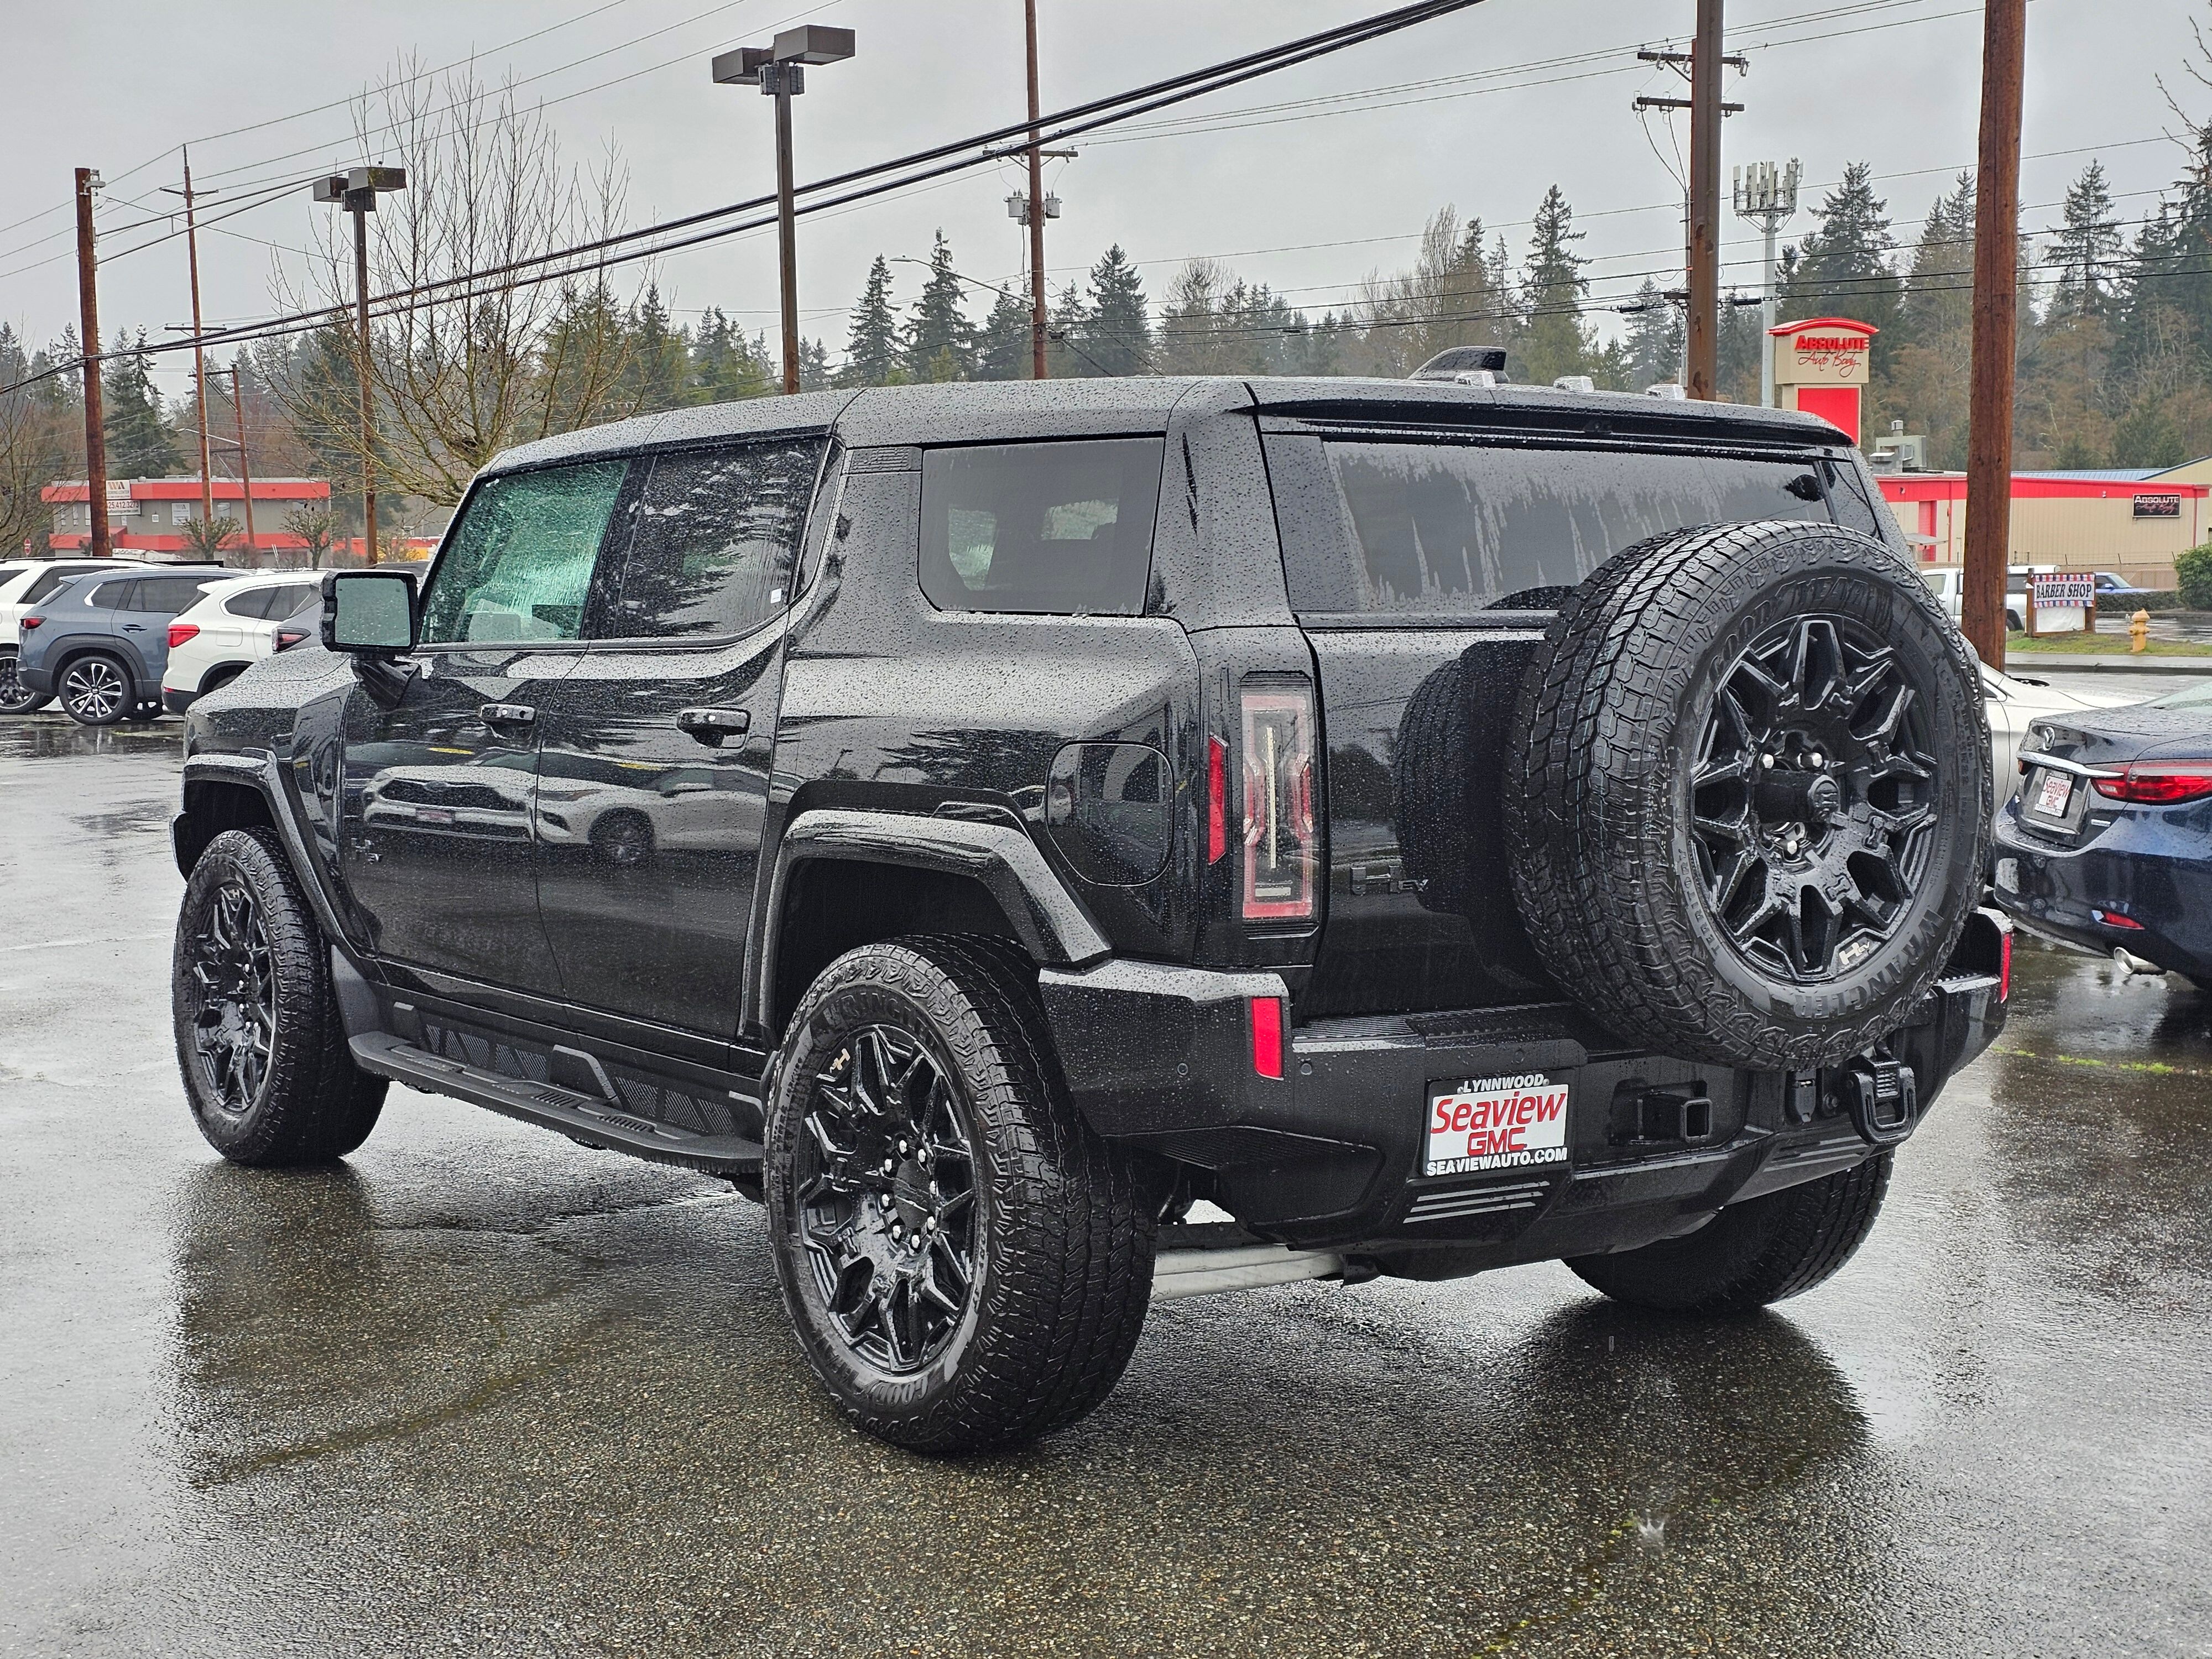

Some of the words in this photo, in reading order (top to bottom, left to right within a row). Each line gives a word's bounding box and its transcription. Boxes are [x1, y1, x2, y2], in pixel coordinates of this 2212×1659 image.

[1795, 335, 1869, 350] ABSOLUTE
[1798, 350, 1833, 372] Auto
[1832, 349, 1861, 378] Body
[2135, 495, 2179, 504] ABSOLUTE
[2036, 584, 2066, 598] BARBER
[2067, 583, 2092, 597] SHOP
[2042, 778, 2070, 799] Seaview
[1678, 848, 1720, 957] TERRITORY
[1794, 909, 1945, 1019] WRANGLER
[1463, 1074, 1545, 1093] LYNNWOOD
[1431, 1091, 1567, 1134] Seaview
[1467, 1126, 1526, 1156] GMC
[1427, 1147, 1568, 1176] SEAVIEWAUTO.COM
